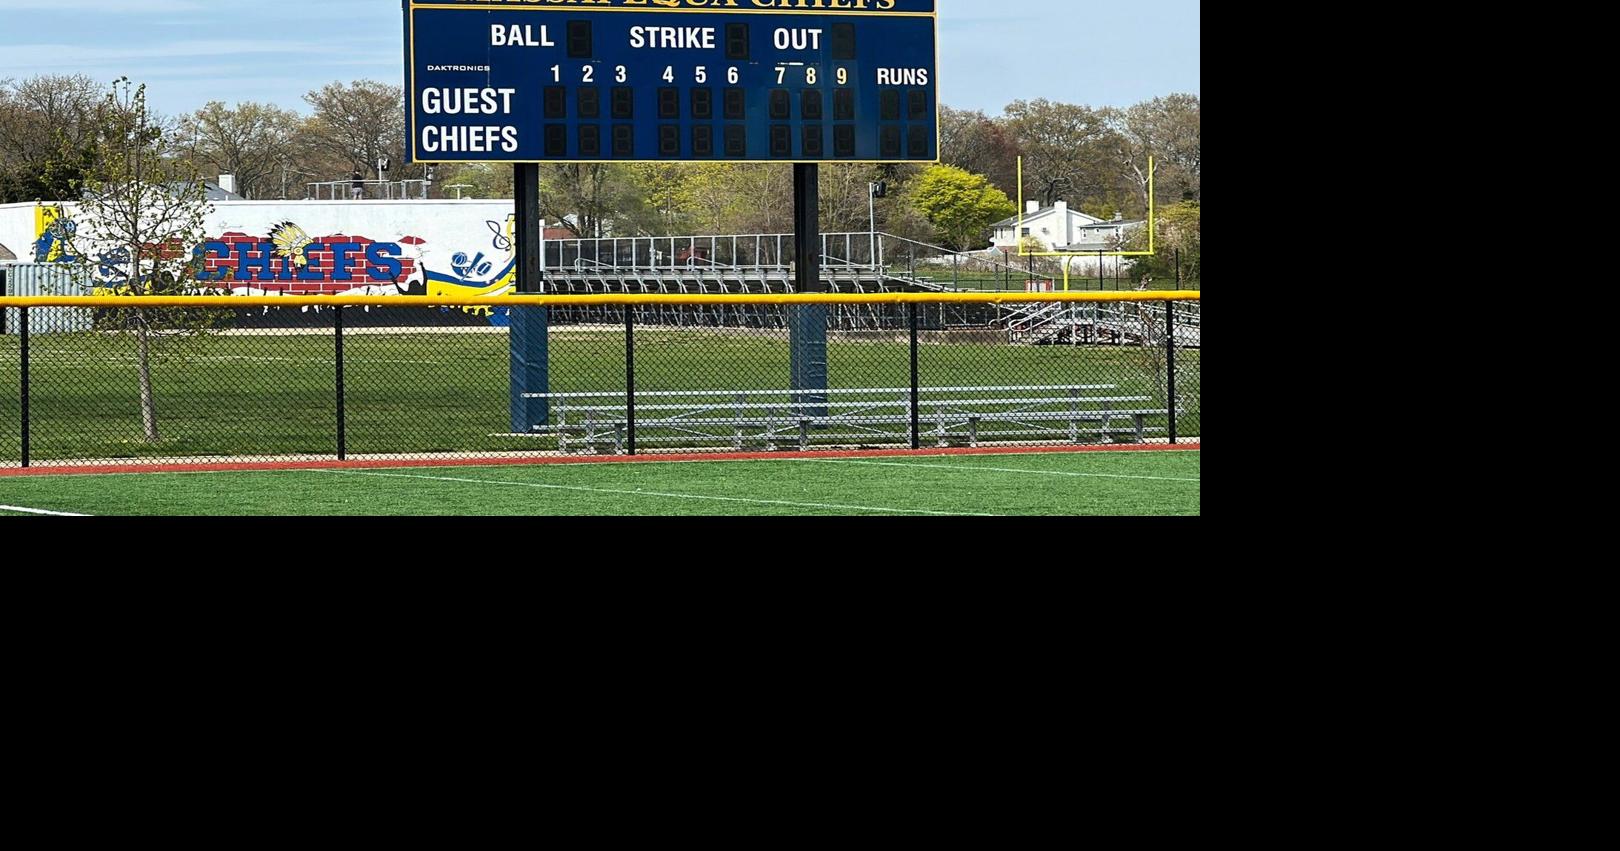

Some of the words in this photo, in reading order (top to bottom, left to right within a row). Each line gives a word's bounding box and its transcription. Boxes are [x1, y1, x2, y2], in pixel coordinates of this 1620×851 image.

[490, 24, 555, 47] BALL
[629, 26, 716, 49] STRIKE
[773, 27, 823, 50] OUT
[550, 64, 560, 82] 1
[582, 65, 594, 82] 2
[615, 65, 627, 83] 3
[662, 66, 674, 83] 4
[695, 66, 707, 83] 5
[727, 67, 739, 84] 6
[774, 67, 786, 84] 7
[806, 67, 817, 84] 8
[836, 67, 848, 85] 9
[876, 68, 928, 86] RUNS
[422, 87, 516, 115] GUEST
[422, 125, 518, 153] CHIEFS
[192, 241, 403, 281] CHIEFS
